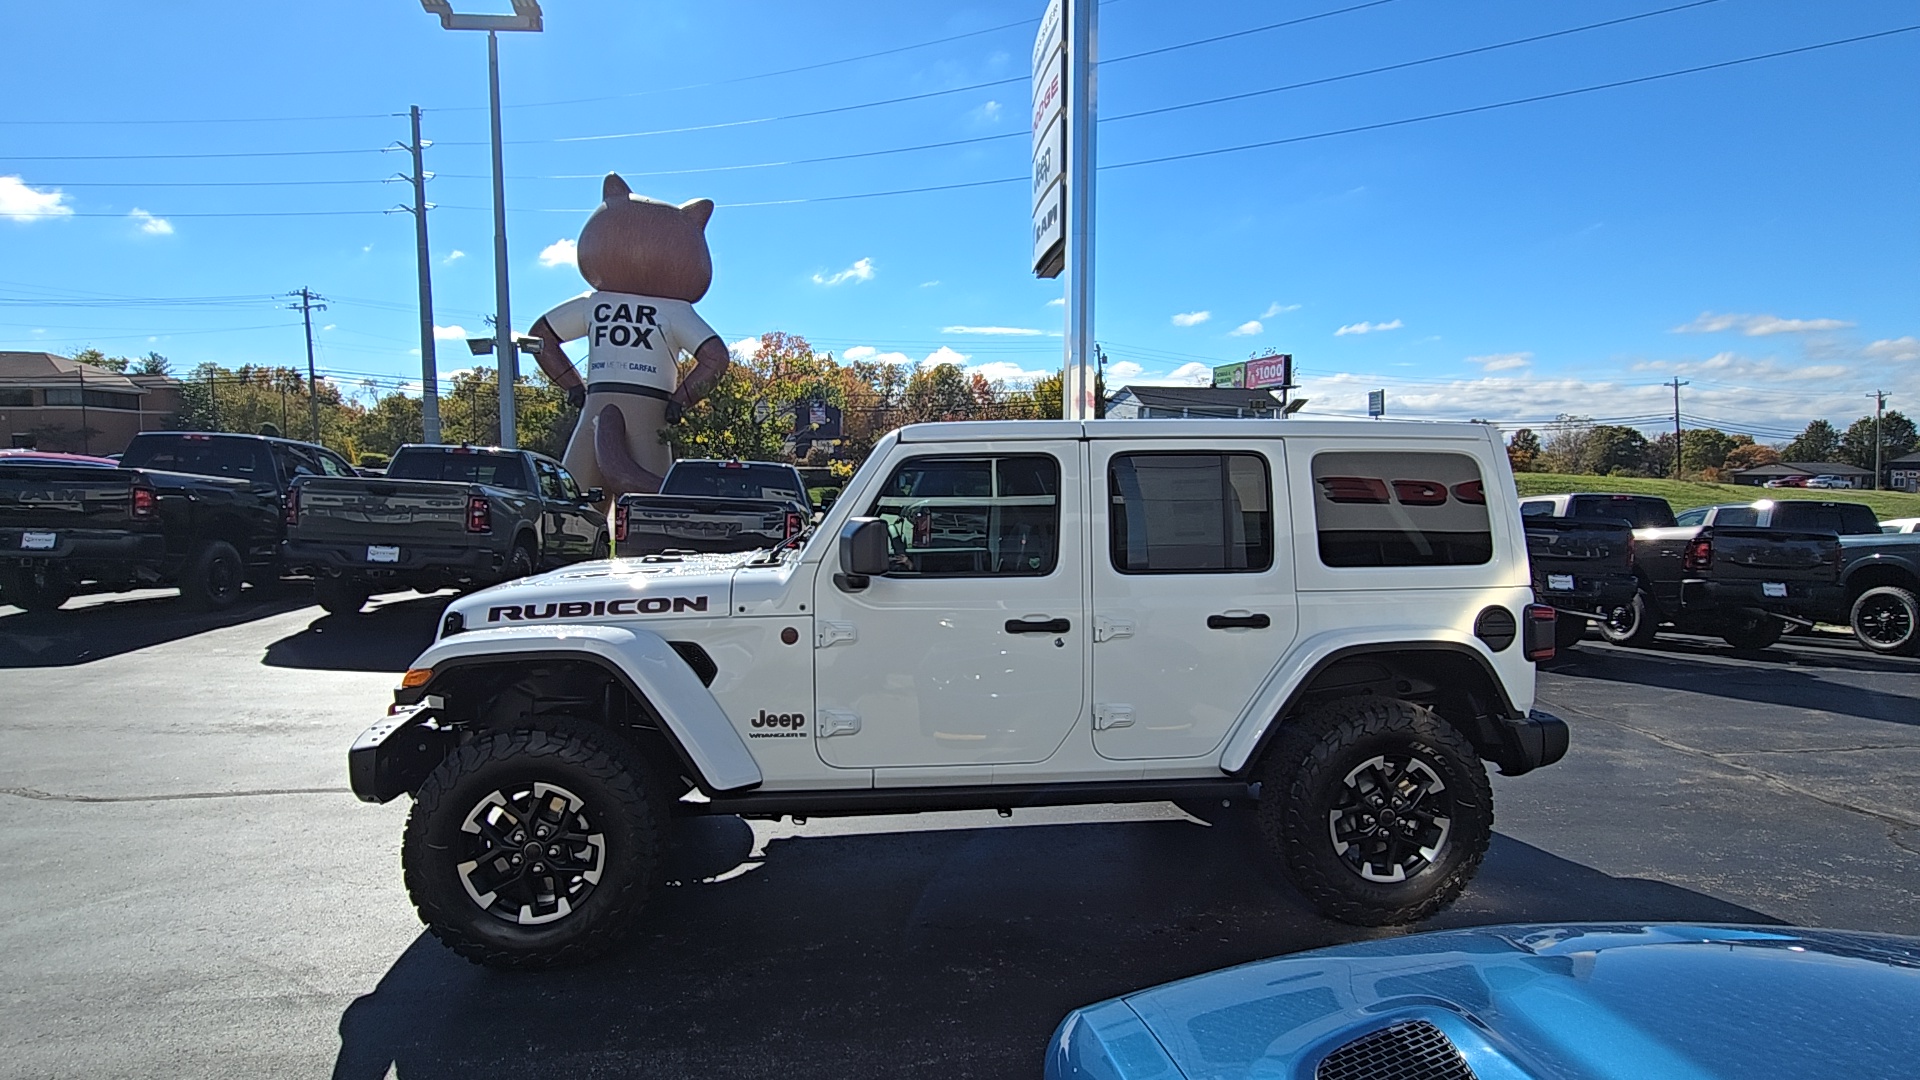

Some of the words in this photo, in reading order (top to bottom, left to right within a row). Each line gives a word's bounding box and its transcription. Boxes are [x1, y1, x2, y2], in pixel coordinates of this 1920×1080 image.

[594, 303, 657, 326] CAR
[594, 325, 654, 350] FOX
[629, 363, 657, 373] CARFAX
[1256, 363, 1282, 379] $1000
[487, 596, 708, 622] RUBICON
[751, 710, 805, 730] Jeep
